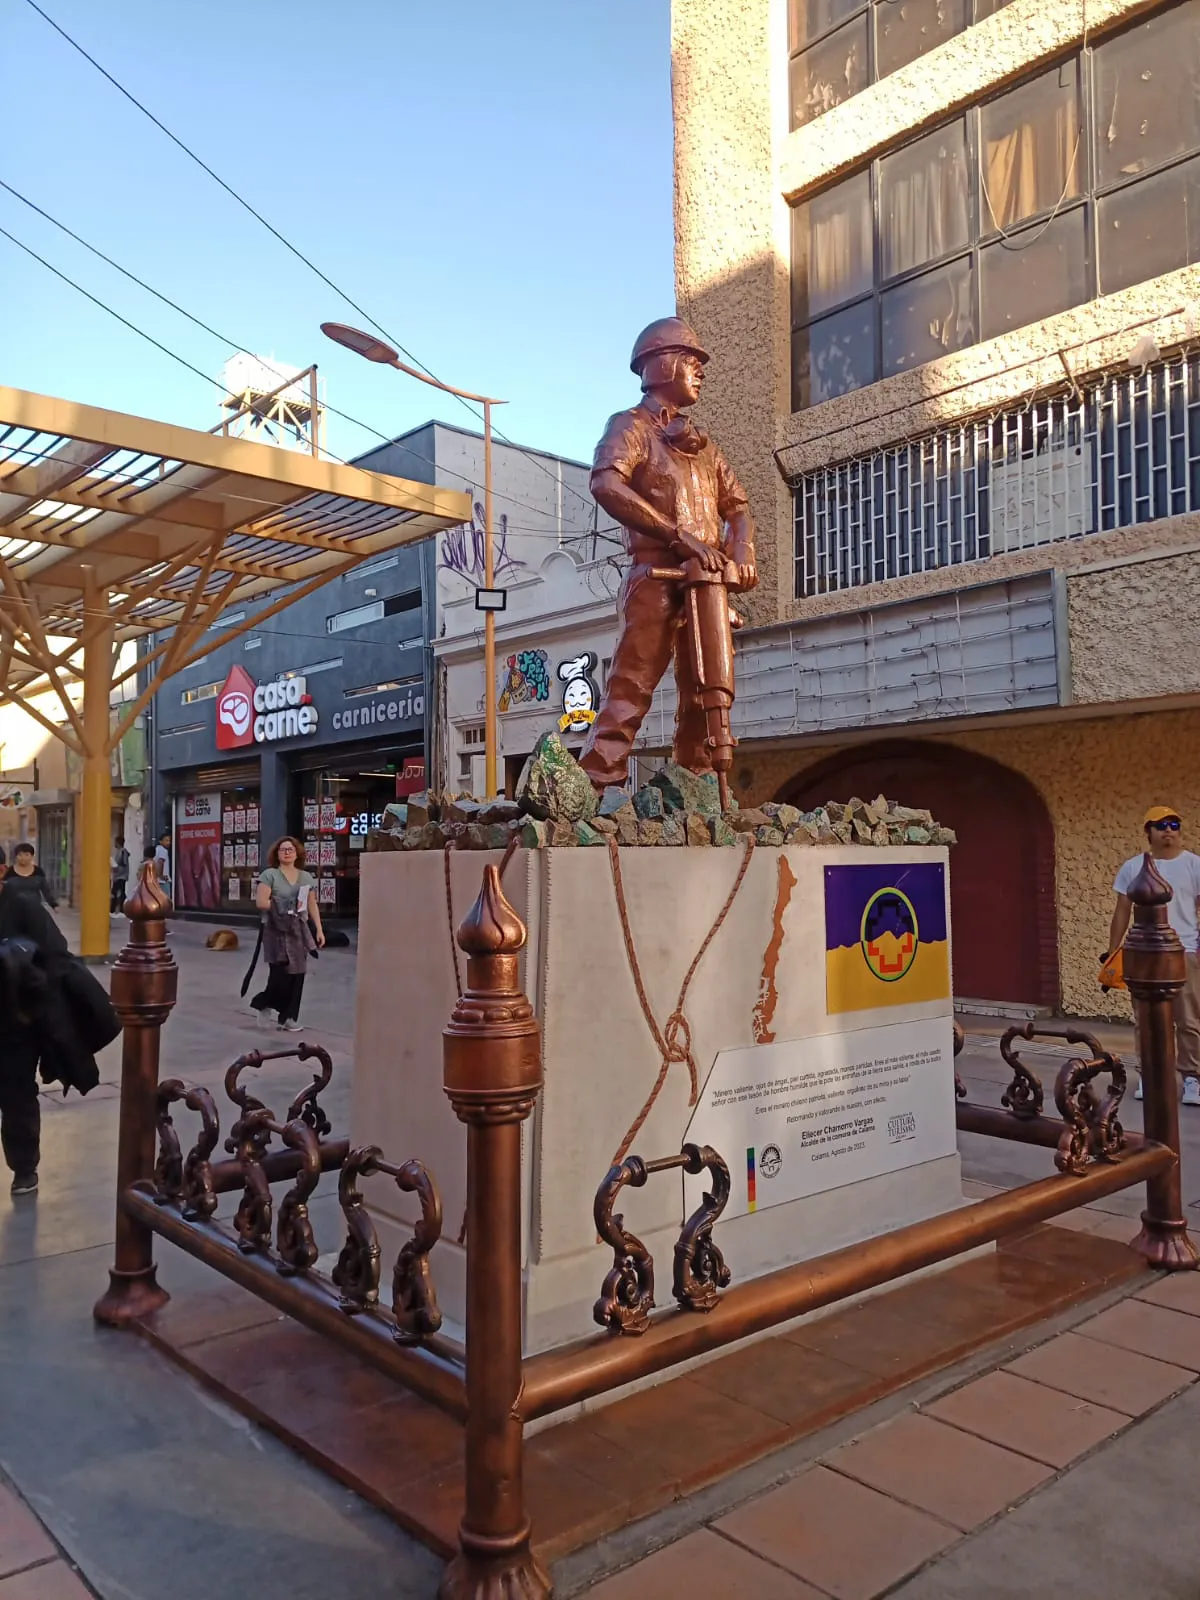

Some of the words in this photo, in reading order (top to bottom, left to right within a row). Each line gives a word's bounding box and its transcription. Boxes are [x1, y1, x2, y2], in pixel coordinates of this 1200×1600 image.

[253, 676, 306, 712] casa
[332, 690, 424, 730] carnicería
[253, 706, 318, 743] carne
[823, 1122, 853, 1134] Chamorro
[854, 1118, 873, 1127] Vargas
[888, 1116, 915, 1129] CULTURA
[888, 1124, 916, 1136] TURISMO
